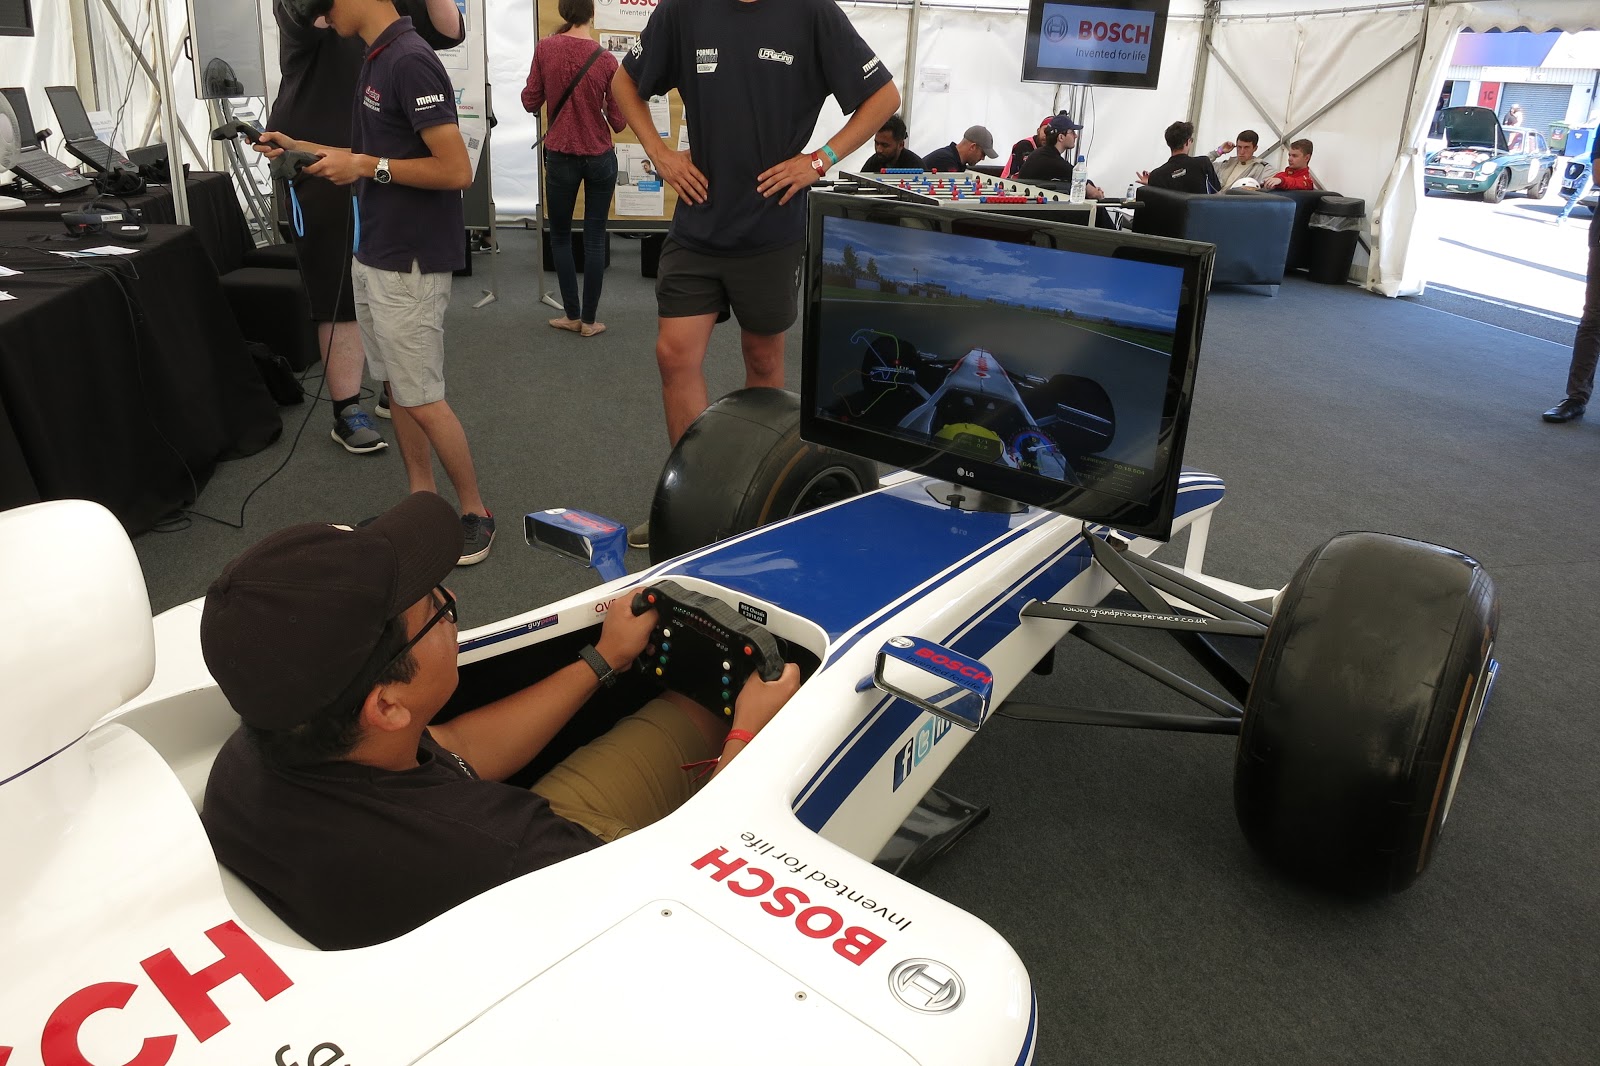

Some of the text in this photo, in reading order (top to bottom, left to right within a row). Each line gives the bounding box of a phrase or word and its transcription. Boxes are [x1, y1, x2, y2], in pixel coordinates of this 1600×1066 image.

[1078, 20, 1150, 44] BOSCH
[696, 48, 718, 56] FORMULA
[1075, 47, 1146, 61] Invented for life
[415, 93, 445, 106] MAHLE
[1483, 91, 1494, 100] 1C
[1062, 606, 1208, 625] www.grandprixexperience.co.uk
[914, 647, 993, 684] BOSCH
[965, 678, 981, 690] life
[740, 831, 912, 932] Invented for life
[690, 846, 888, 967] BOSCH
